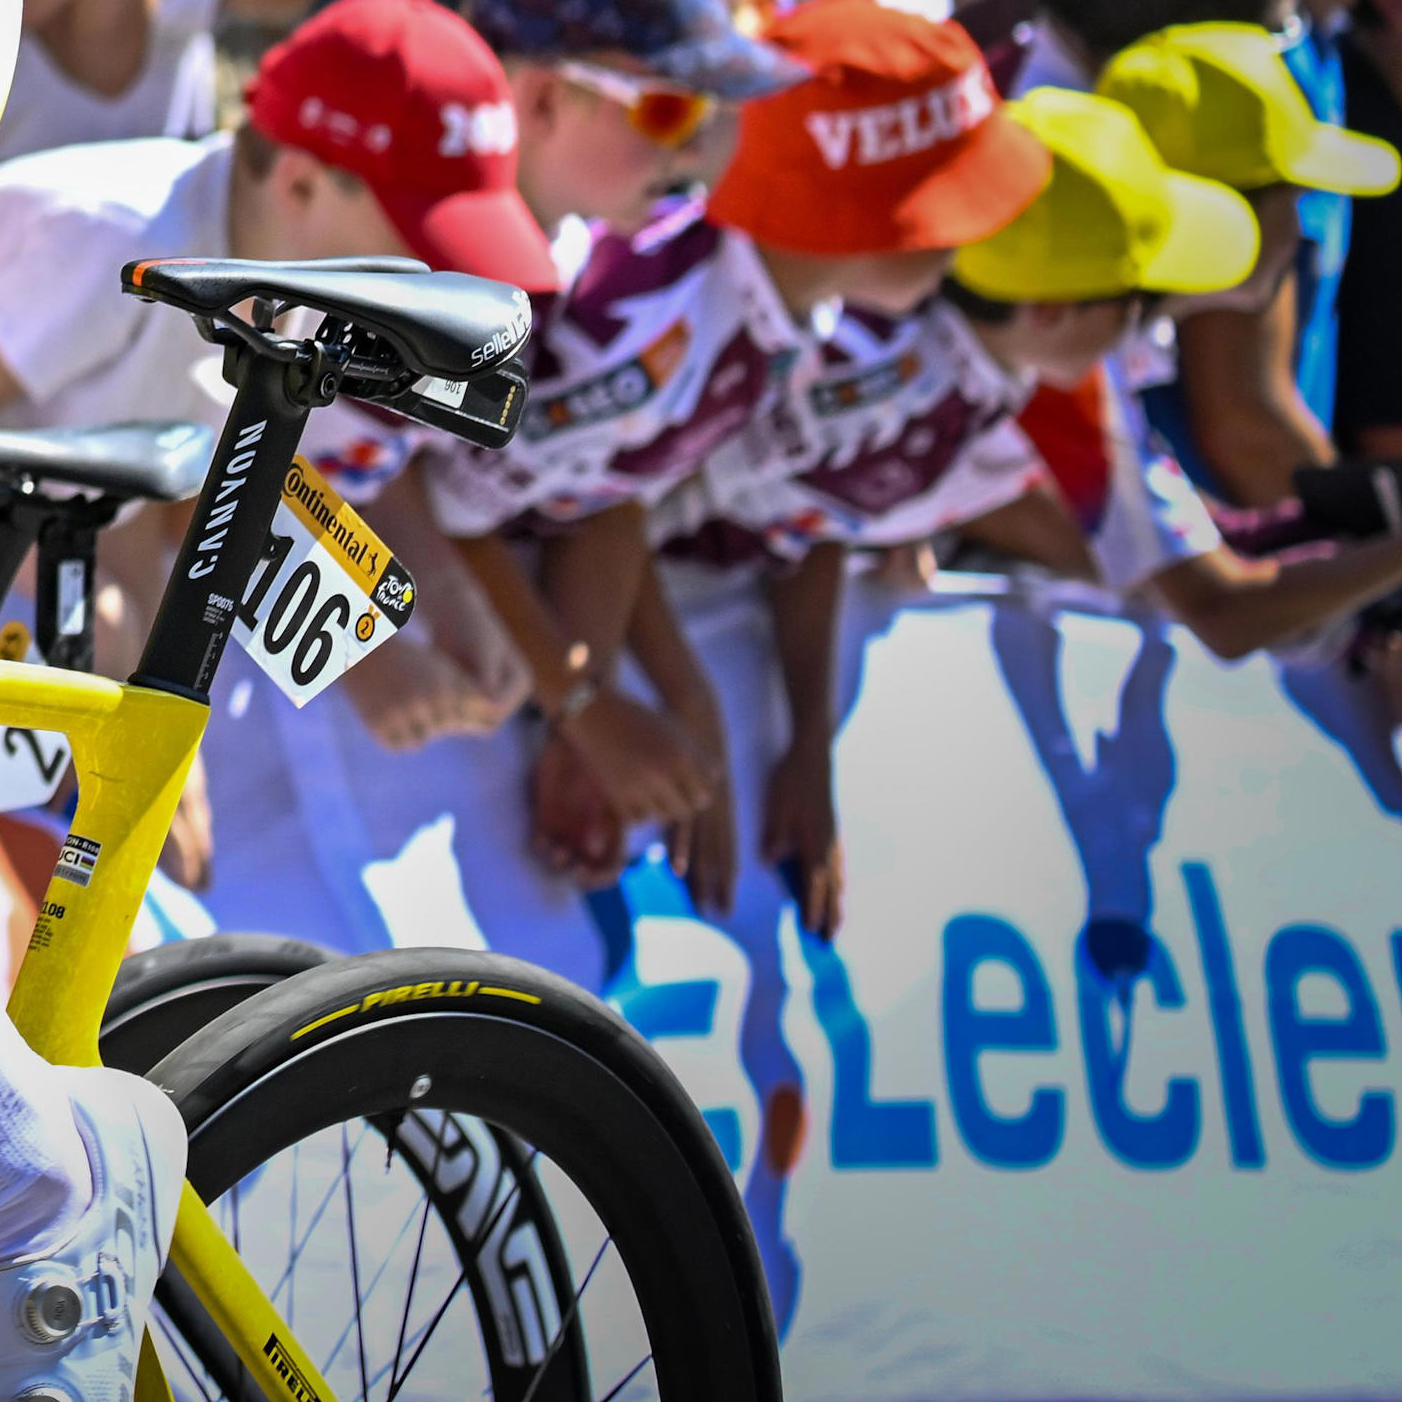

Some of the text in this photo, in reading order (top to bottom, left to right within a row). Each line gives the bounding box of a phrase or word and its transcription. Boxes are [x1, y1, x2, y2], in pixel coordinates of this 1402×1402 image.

[187, 418, 268, 581] CANYON
[281, 460, 369, 568] Continental
[236, 534, 352, 687] 106
[359, 979, 481, 1014] PIRELLI
